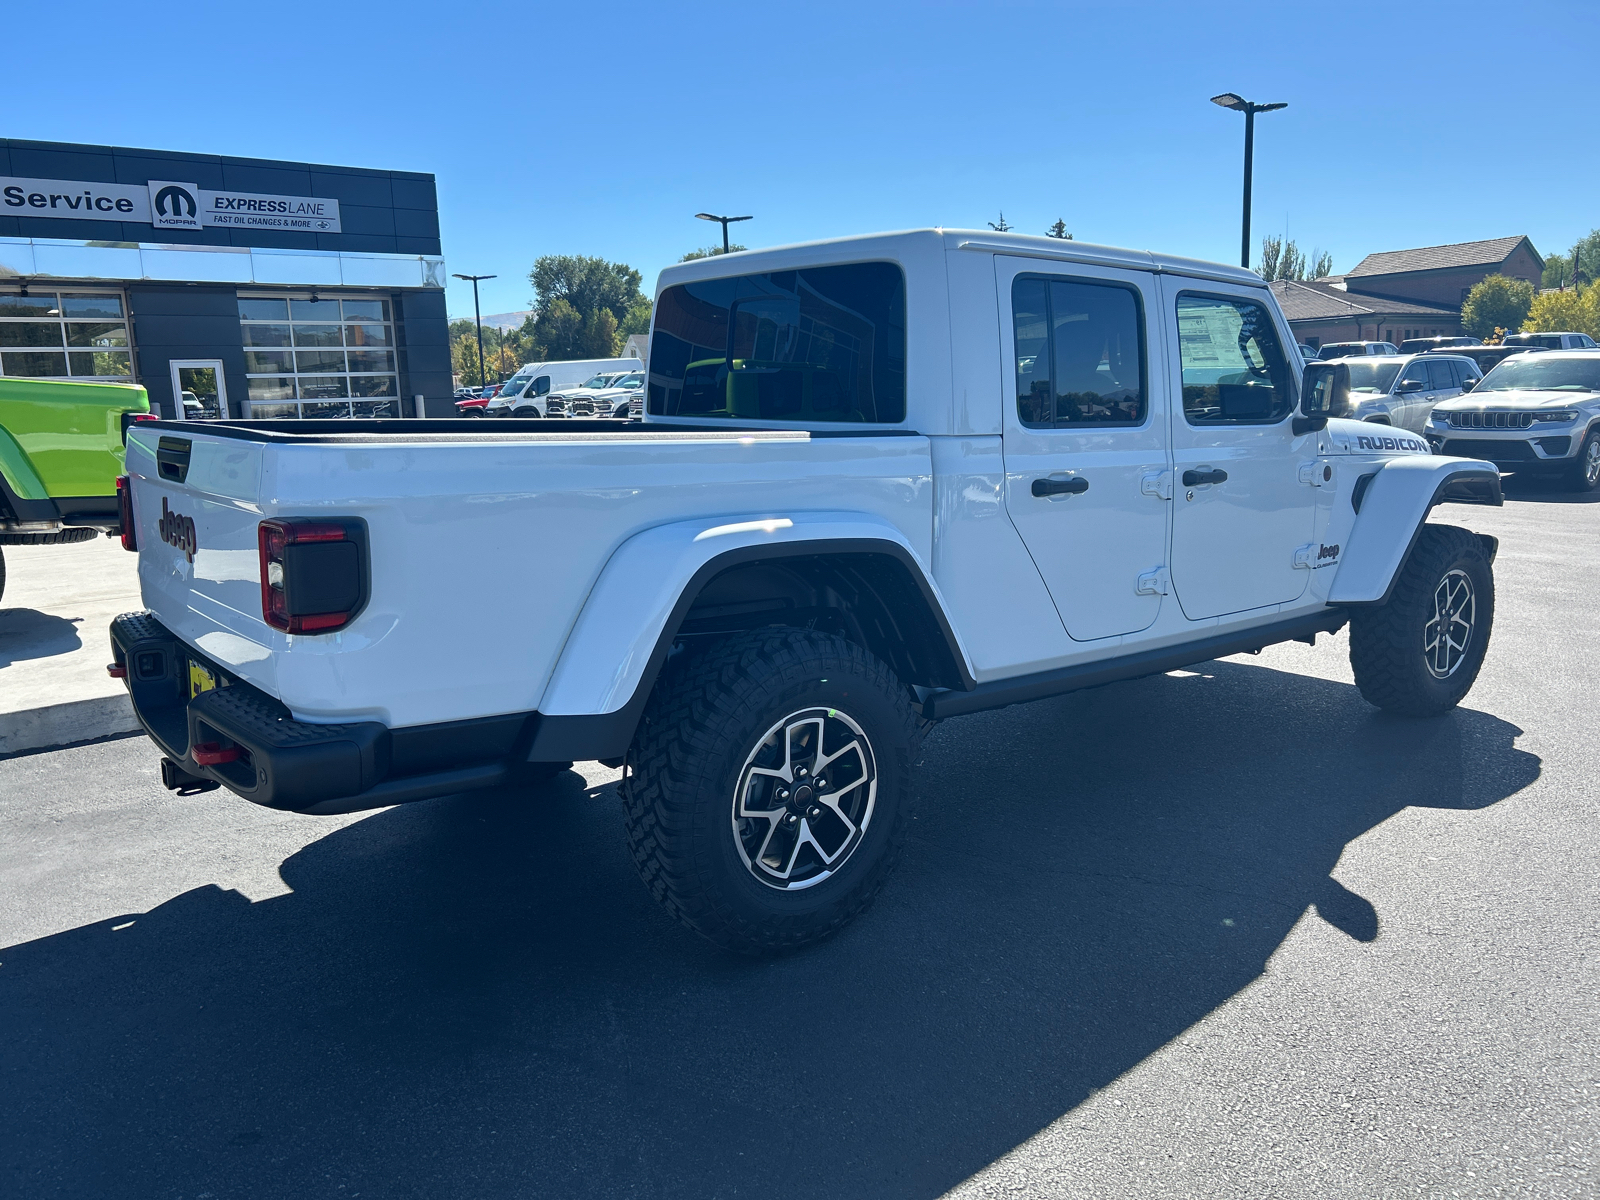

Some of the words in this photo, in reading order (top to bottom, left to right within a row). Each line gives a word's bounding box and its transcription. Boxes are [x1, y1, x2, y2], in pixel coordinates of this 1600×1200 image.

[3, 186, 134, 213] Service
[159, 218, 197, 226] MOPAR
[213, 215, 232, 224] FAST
[234, 216, 246, 224] OIL
[247, 217, 282, 226] CHANGES
[290, 219, 311, 228] MORE
[1357, 436, 1428, 452] RUBICON
[159, 496, 197, 564] Jeep
[1317, 543, 1340, 560] Jeep
